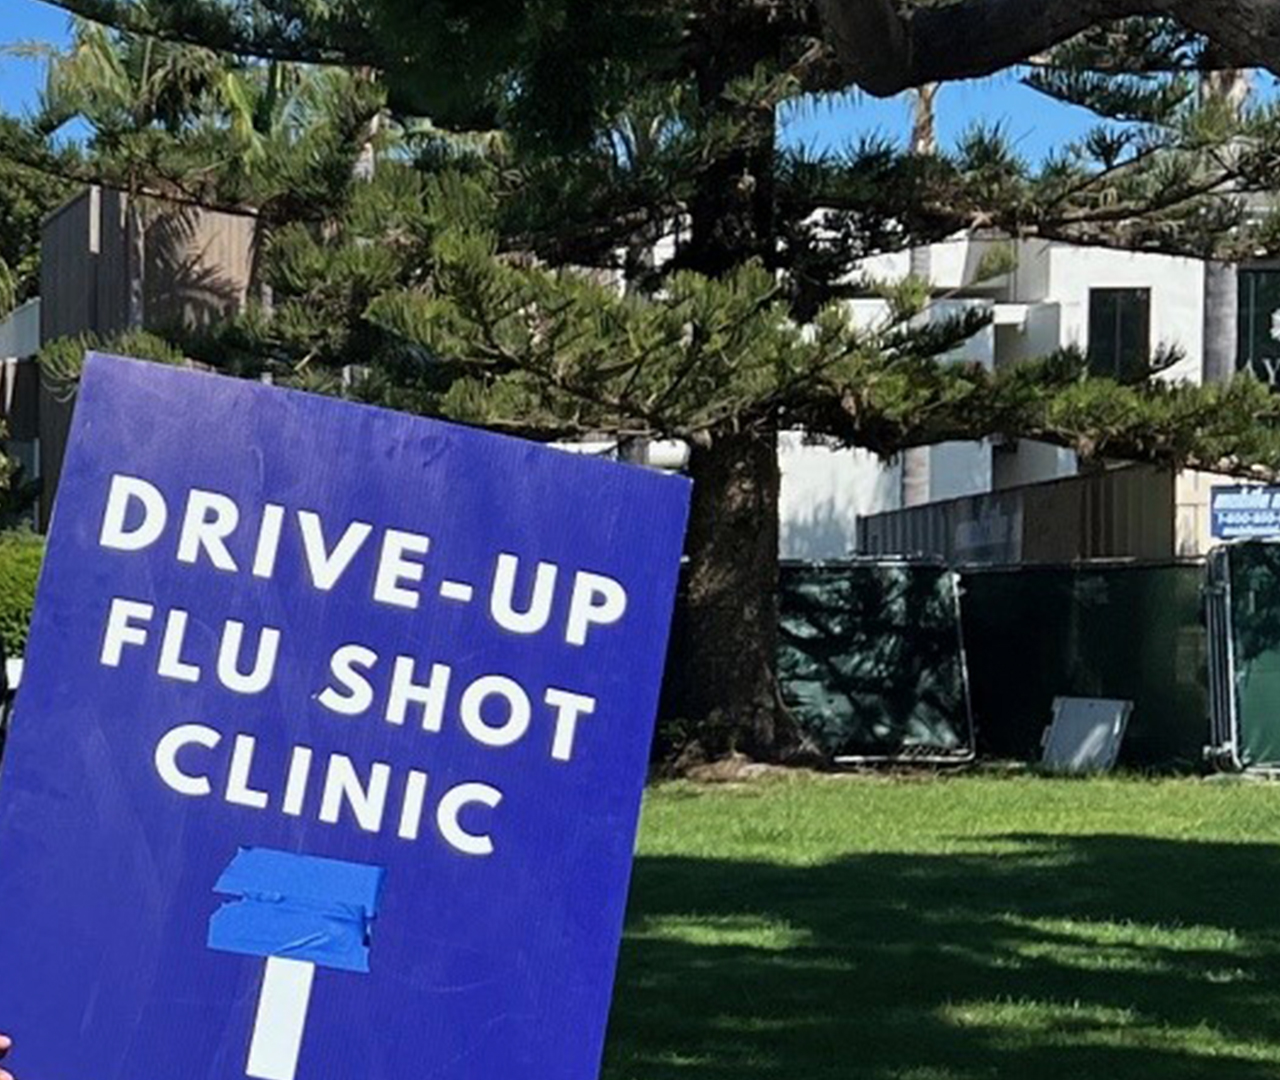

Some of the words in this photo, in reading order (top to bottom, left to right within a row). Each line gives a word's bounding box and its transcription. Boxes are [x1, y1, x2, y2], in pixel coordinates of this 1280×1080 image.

[99, 474, 629, 647] DRIVE-UP
[100, 598, 281, 694] FLU
[316, 644, 597, 762] SHOT
[154, 723, 504, 856] CLINIC
